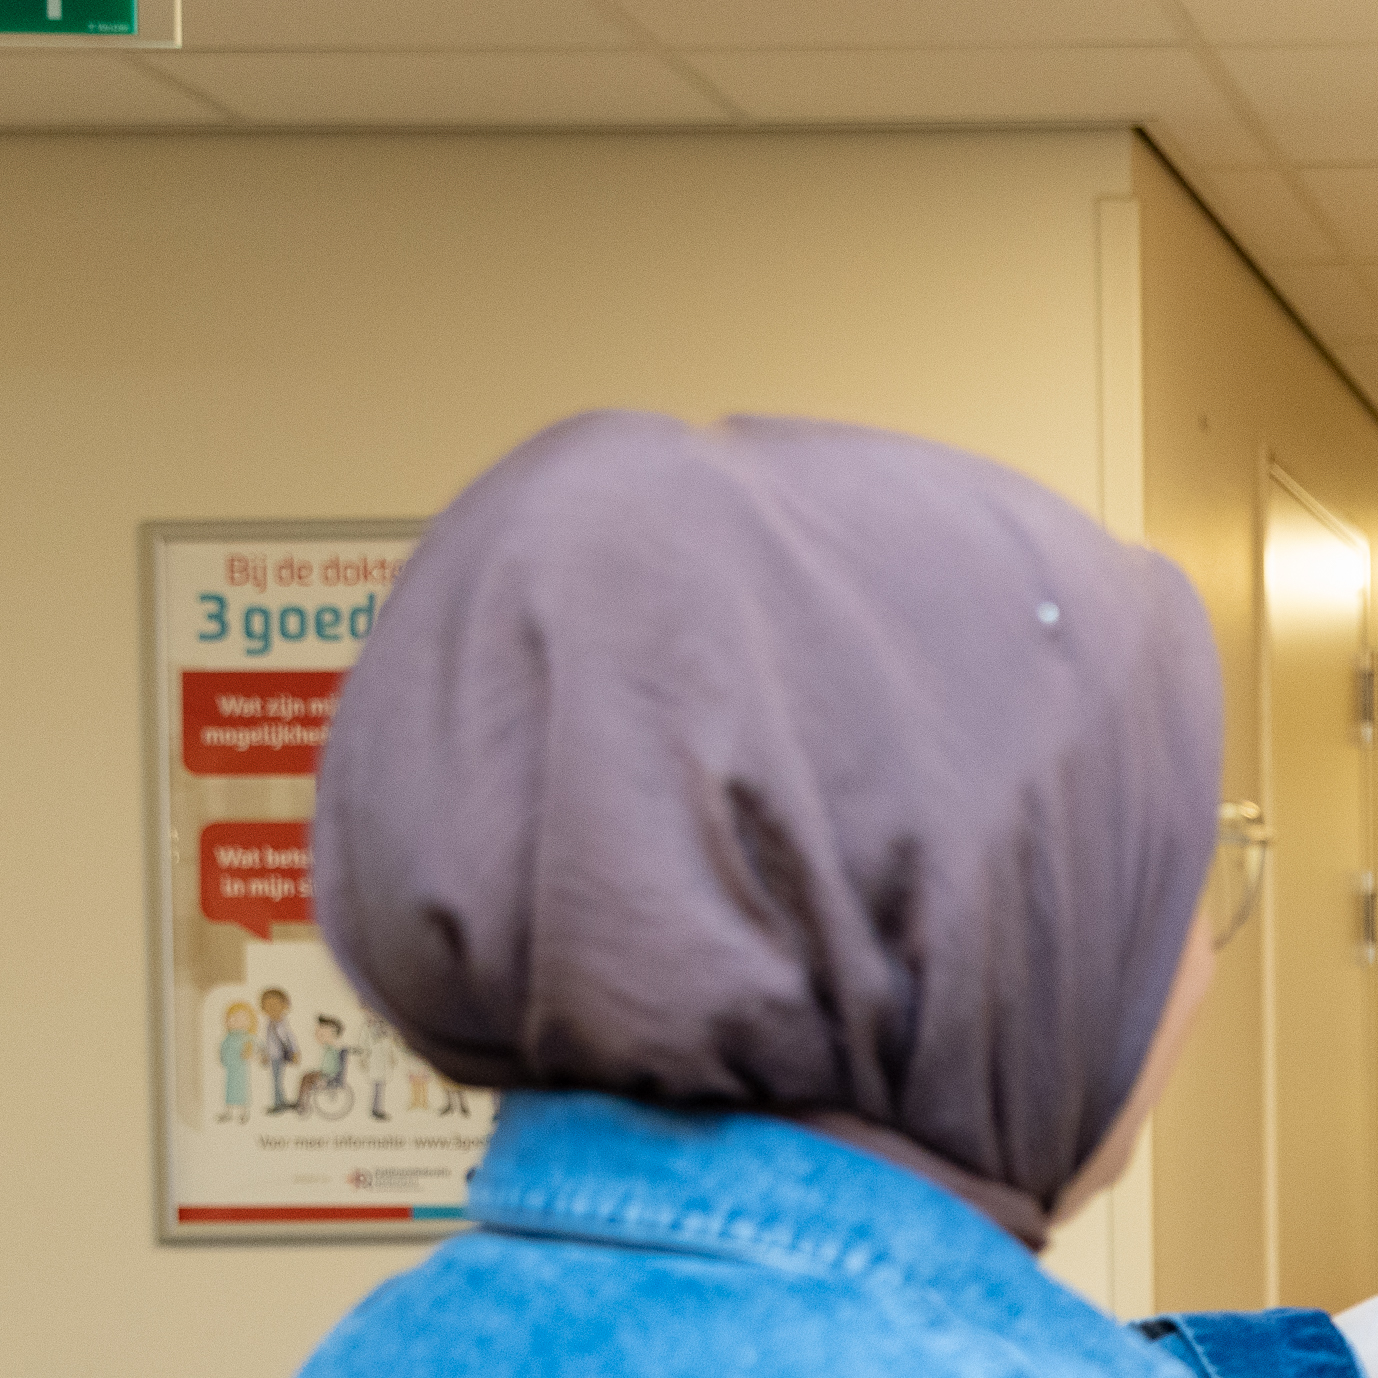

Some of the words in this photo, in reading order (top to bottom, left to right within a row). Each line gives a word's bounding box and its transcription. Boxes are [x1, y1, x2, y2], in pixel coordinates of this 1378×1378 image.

[226, 553, 267, 592] Bij
[276, 555, 314, 587] de
[199, 593, 231, 642] 3
[244, 592, 376, 657] goed
[216, 693, 262, 718] Wat
[266, 692, 307, 722] zijn
[214, 844, 261, 869] Wat
[220, 873, 246, 898] in
[249, 873, 296, 902] mijn
